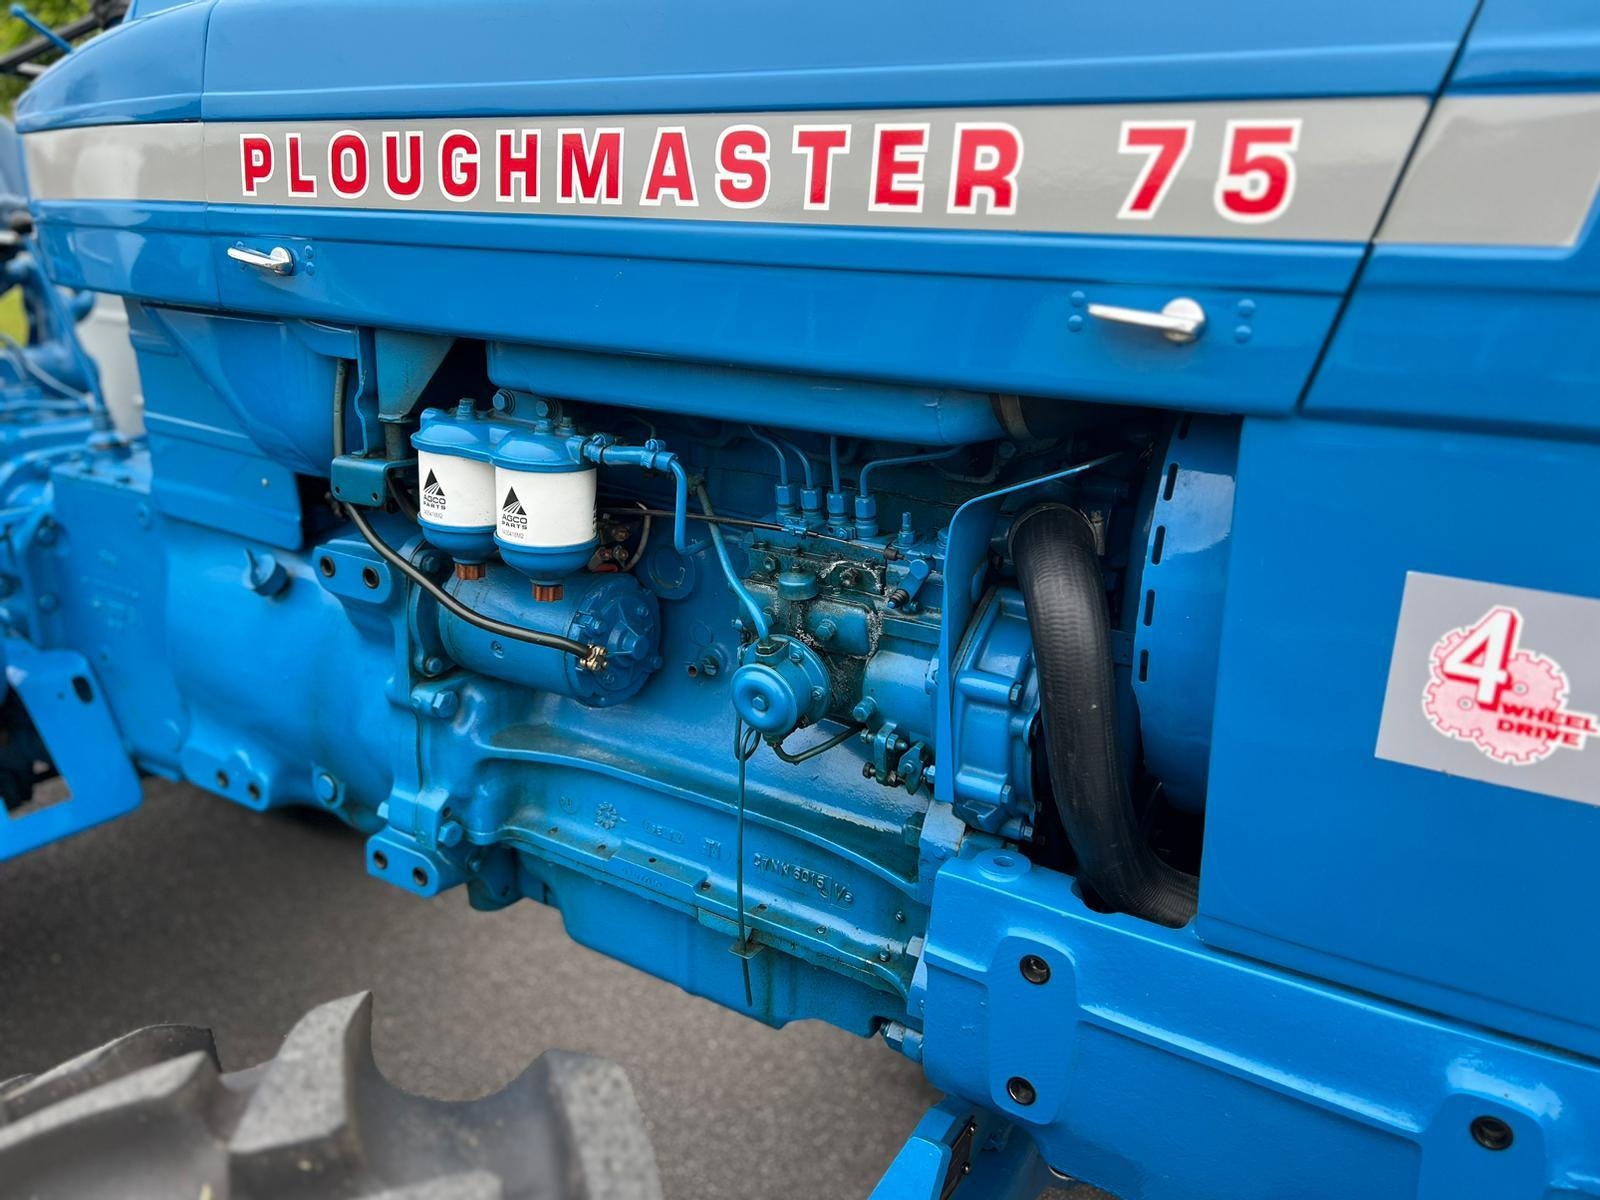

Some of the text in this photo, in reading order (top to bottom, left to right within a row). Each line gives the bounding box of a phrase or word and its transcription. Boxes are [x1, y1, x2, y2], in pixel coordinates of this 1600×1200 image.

[238, 119, 1302, 224] PLOUGHMASTER 75
[502, 513, 528, 525] AGCO
[502, 521, 528, 530] PARTS
[1442, 608, 1518, 711] 4
[1502, 702, 1598, 732] WHEEL
[1497, 719, 1581, 746] DRIVE
